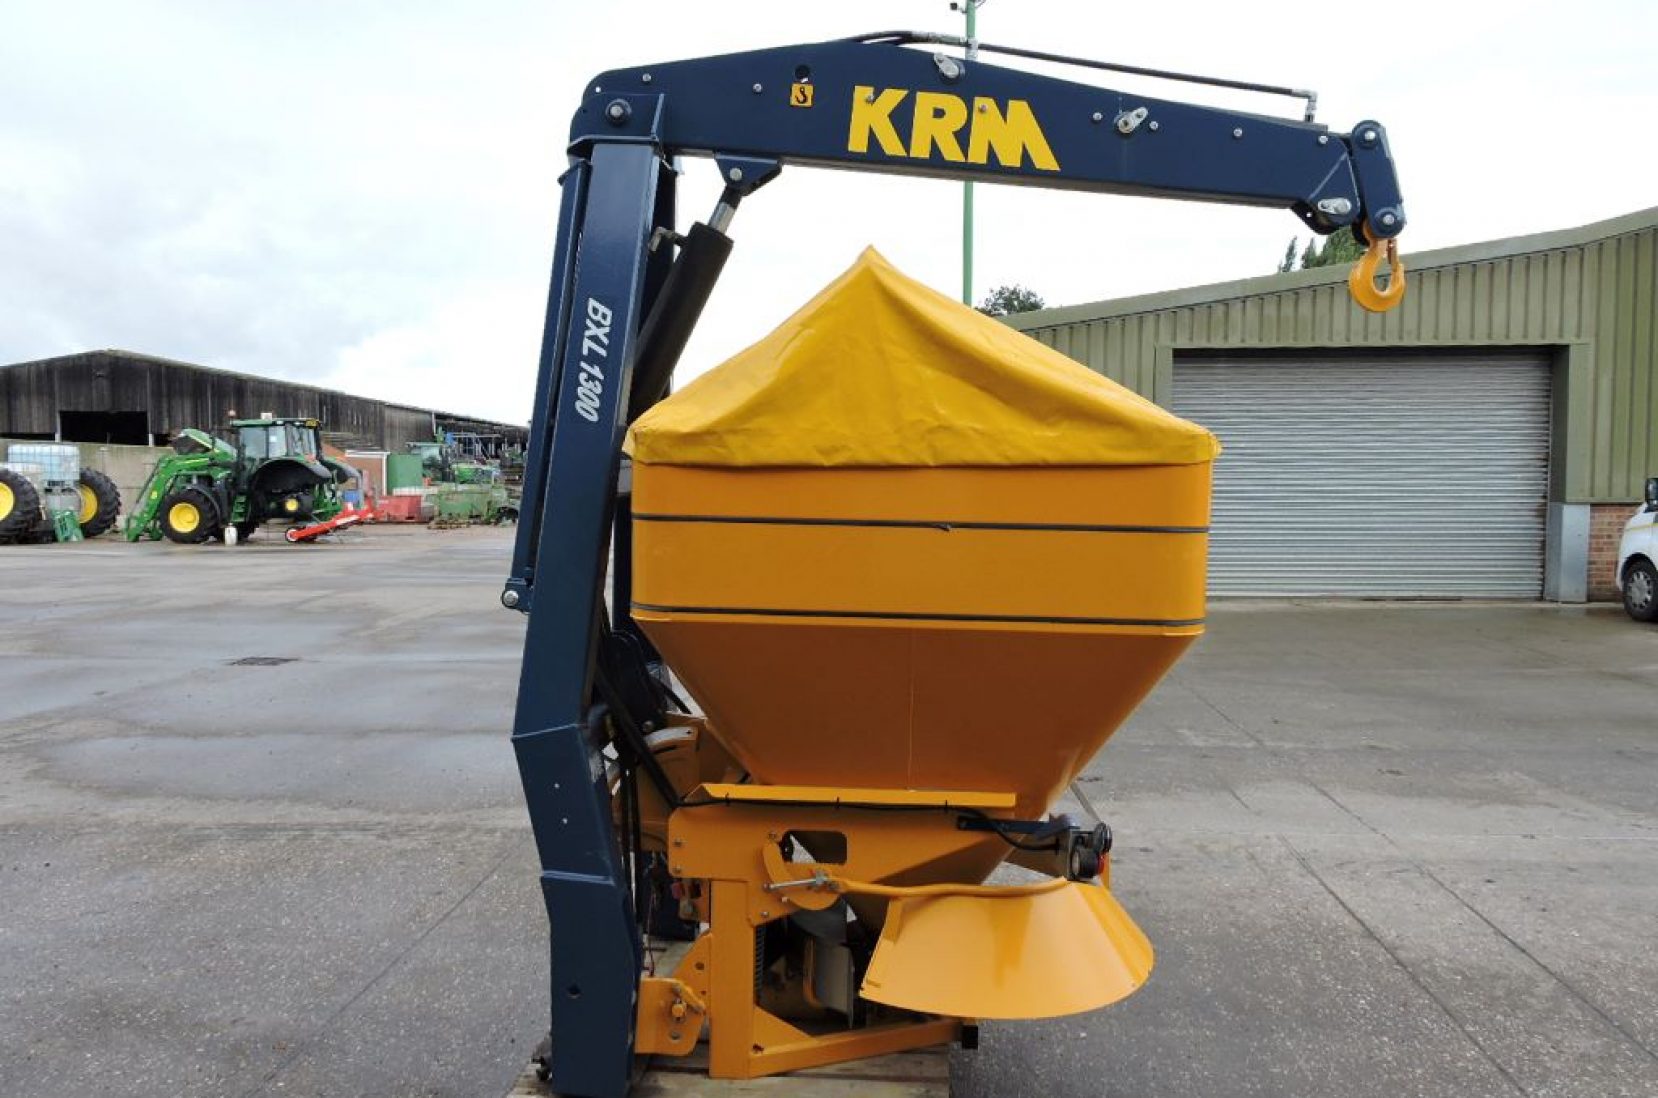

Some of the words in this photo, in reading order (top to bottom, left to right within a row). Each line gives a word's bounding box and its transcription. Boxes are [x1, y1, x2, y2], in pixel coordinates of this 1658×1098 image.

[847, 85, 1060, 171] KRM
[582, 297, 613, 357] BXL
[574, 360, 605, 422] 1300
